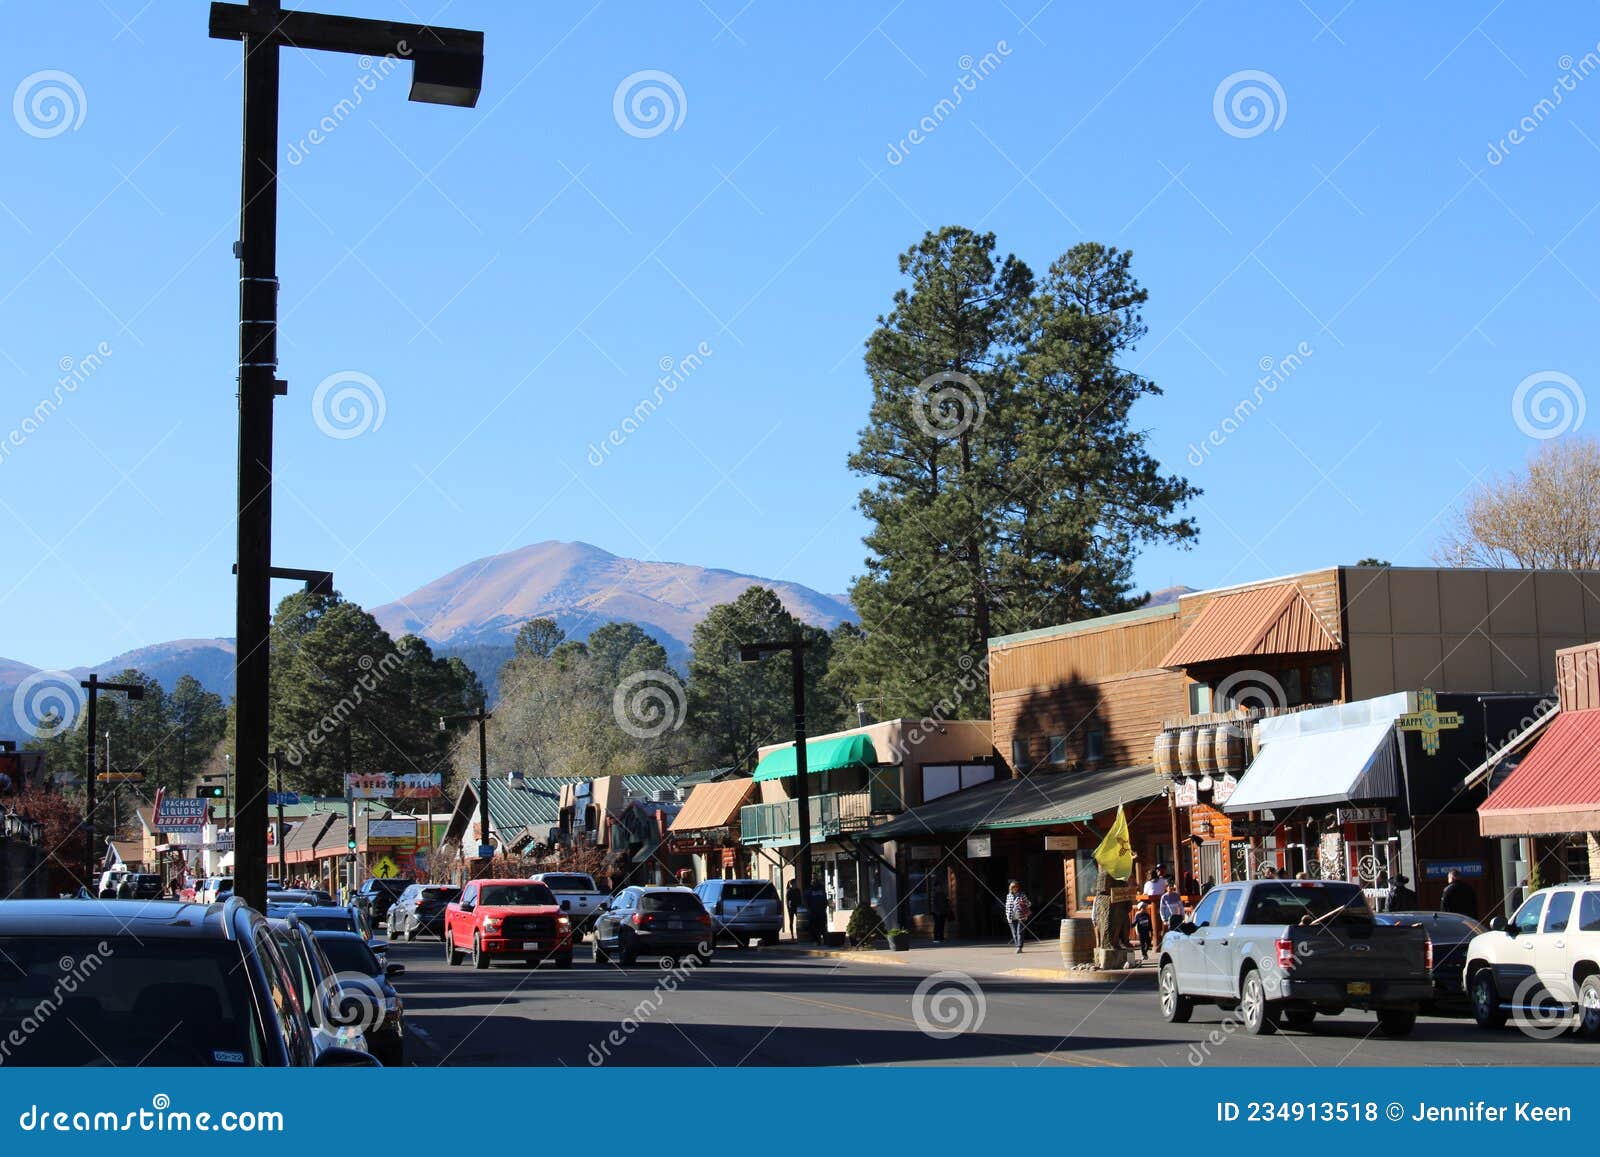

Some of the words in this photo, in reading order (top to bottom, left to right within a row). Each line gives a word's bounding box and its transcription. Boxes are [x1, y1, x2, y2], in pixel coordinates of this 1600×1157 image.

[1400, 717, 1423, 727] HAPPY
[160, 807, 203, 816] LIQUORS
[157, 817, 190, 825] DRIVE
[193, 817, 204, 825] IN
